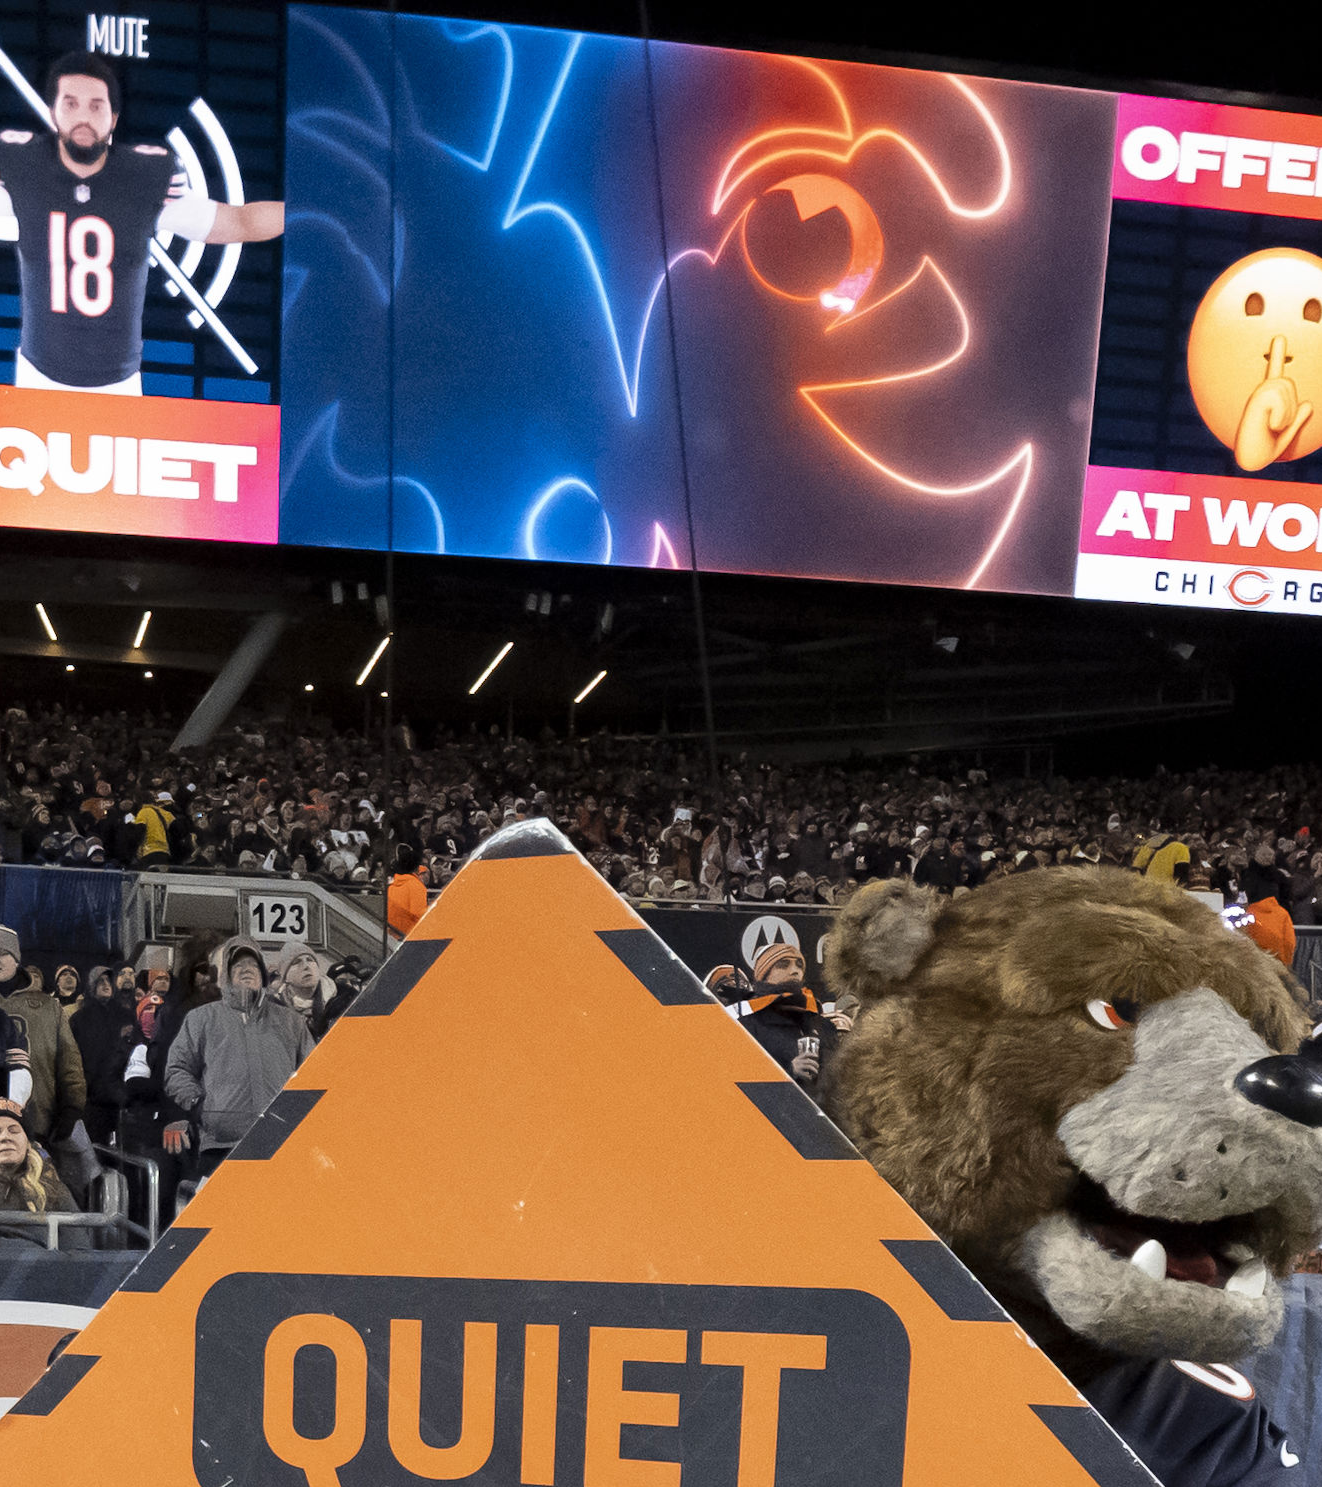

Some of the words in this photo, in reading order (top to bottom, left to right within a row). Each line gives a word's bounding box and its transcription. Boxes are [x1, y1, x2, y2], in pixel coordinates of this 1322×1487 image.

[88, 14, 149, 59] MUTE
[49, 210, 115, 317] 18
[1096, 489, 1191, 542] AT
[251, 903, 306, 935] 123
